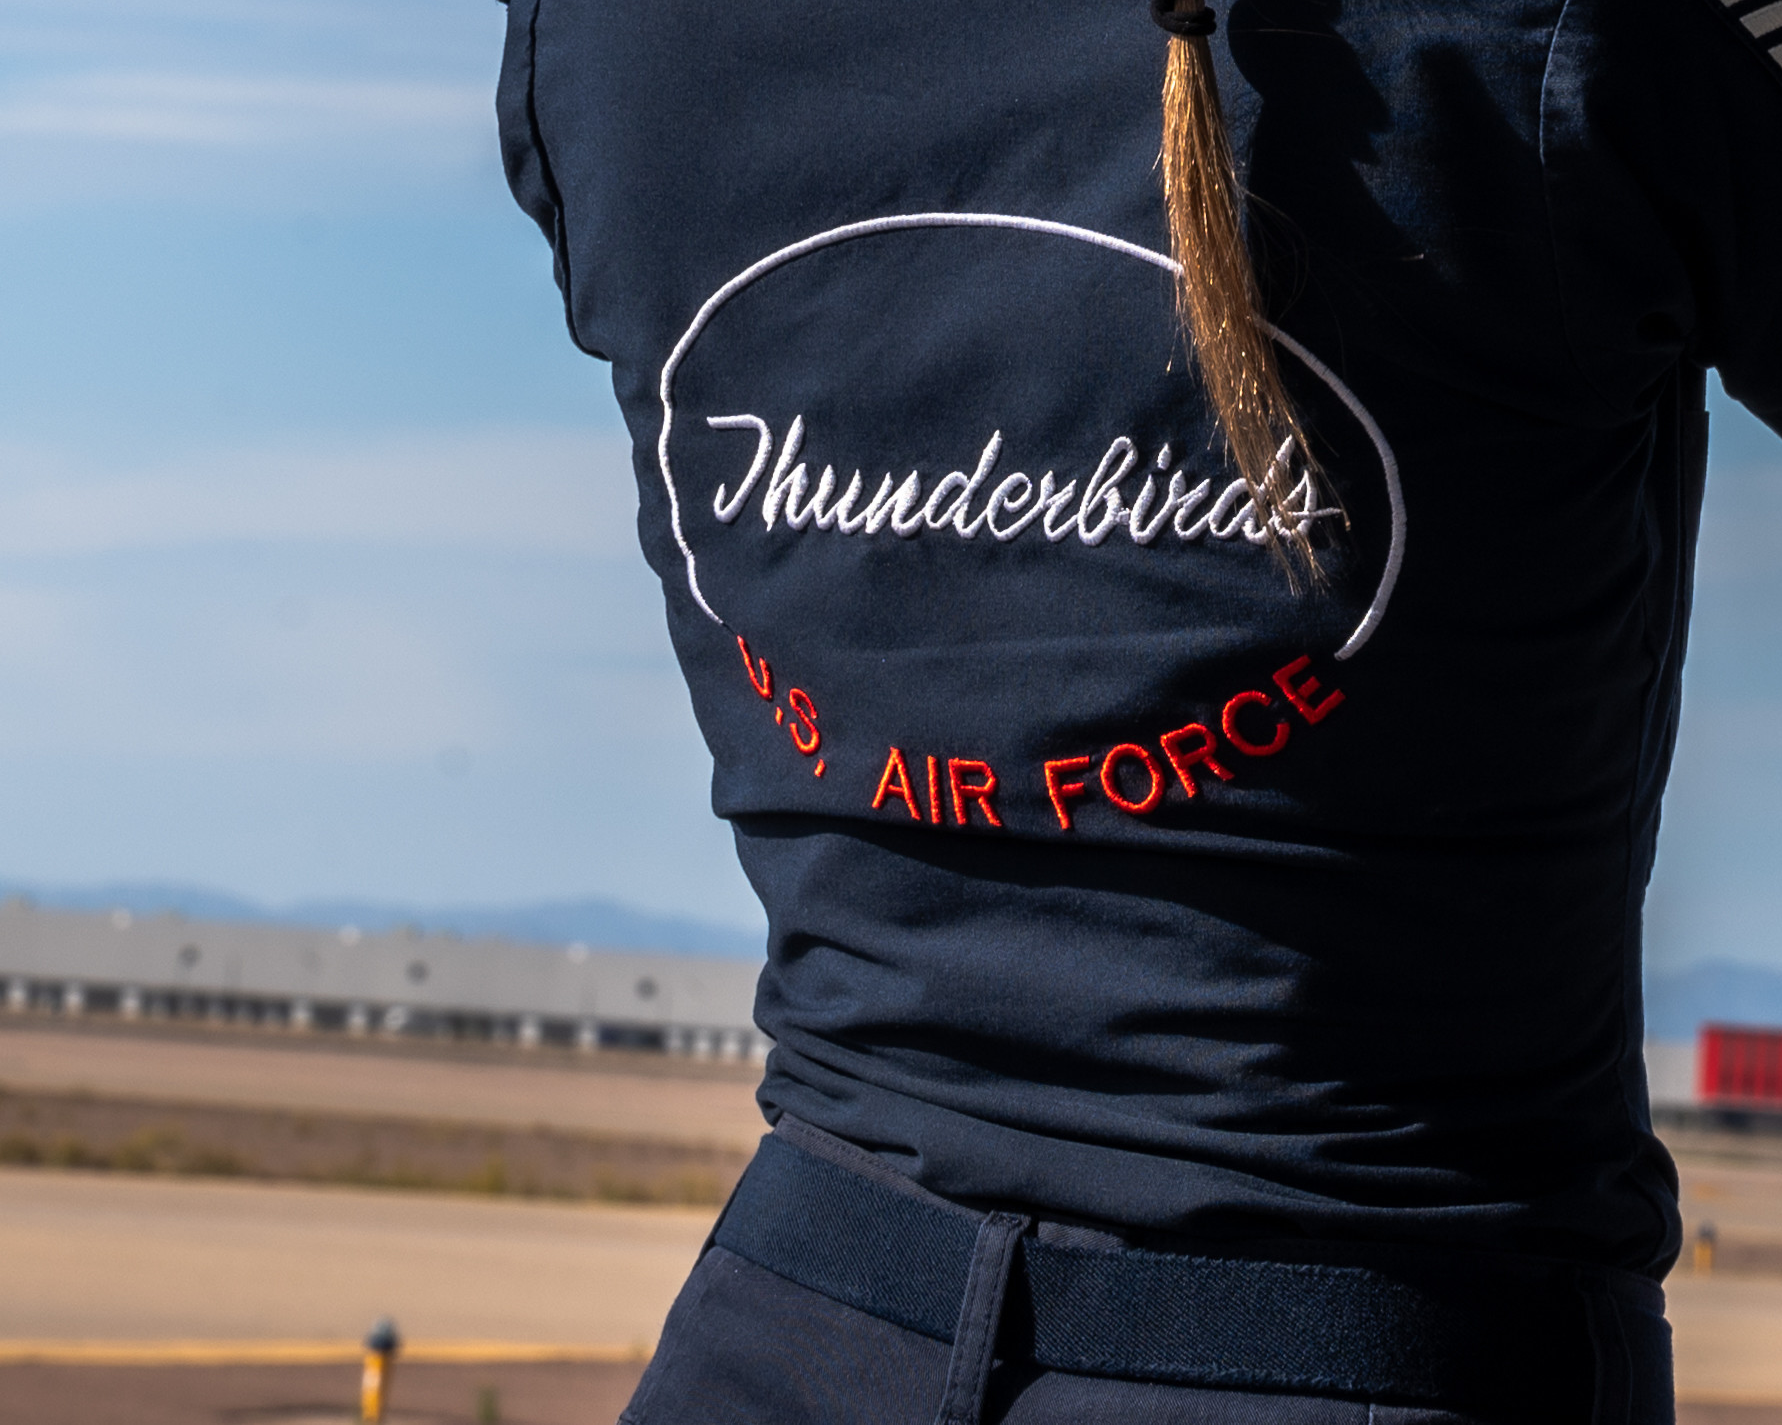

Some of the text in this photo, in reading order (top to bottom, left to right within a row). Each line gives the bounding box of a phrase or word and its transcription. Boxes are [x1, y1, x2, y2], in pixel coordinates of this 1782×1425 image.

[706, 413, 1343, 546] Thunderbirds
[736, 635, 1345, 830] U.S. AIR FORCE
